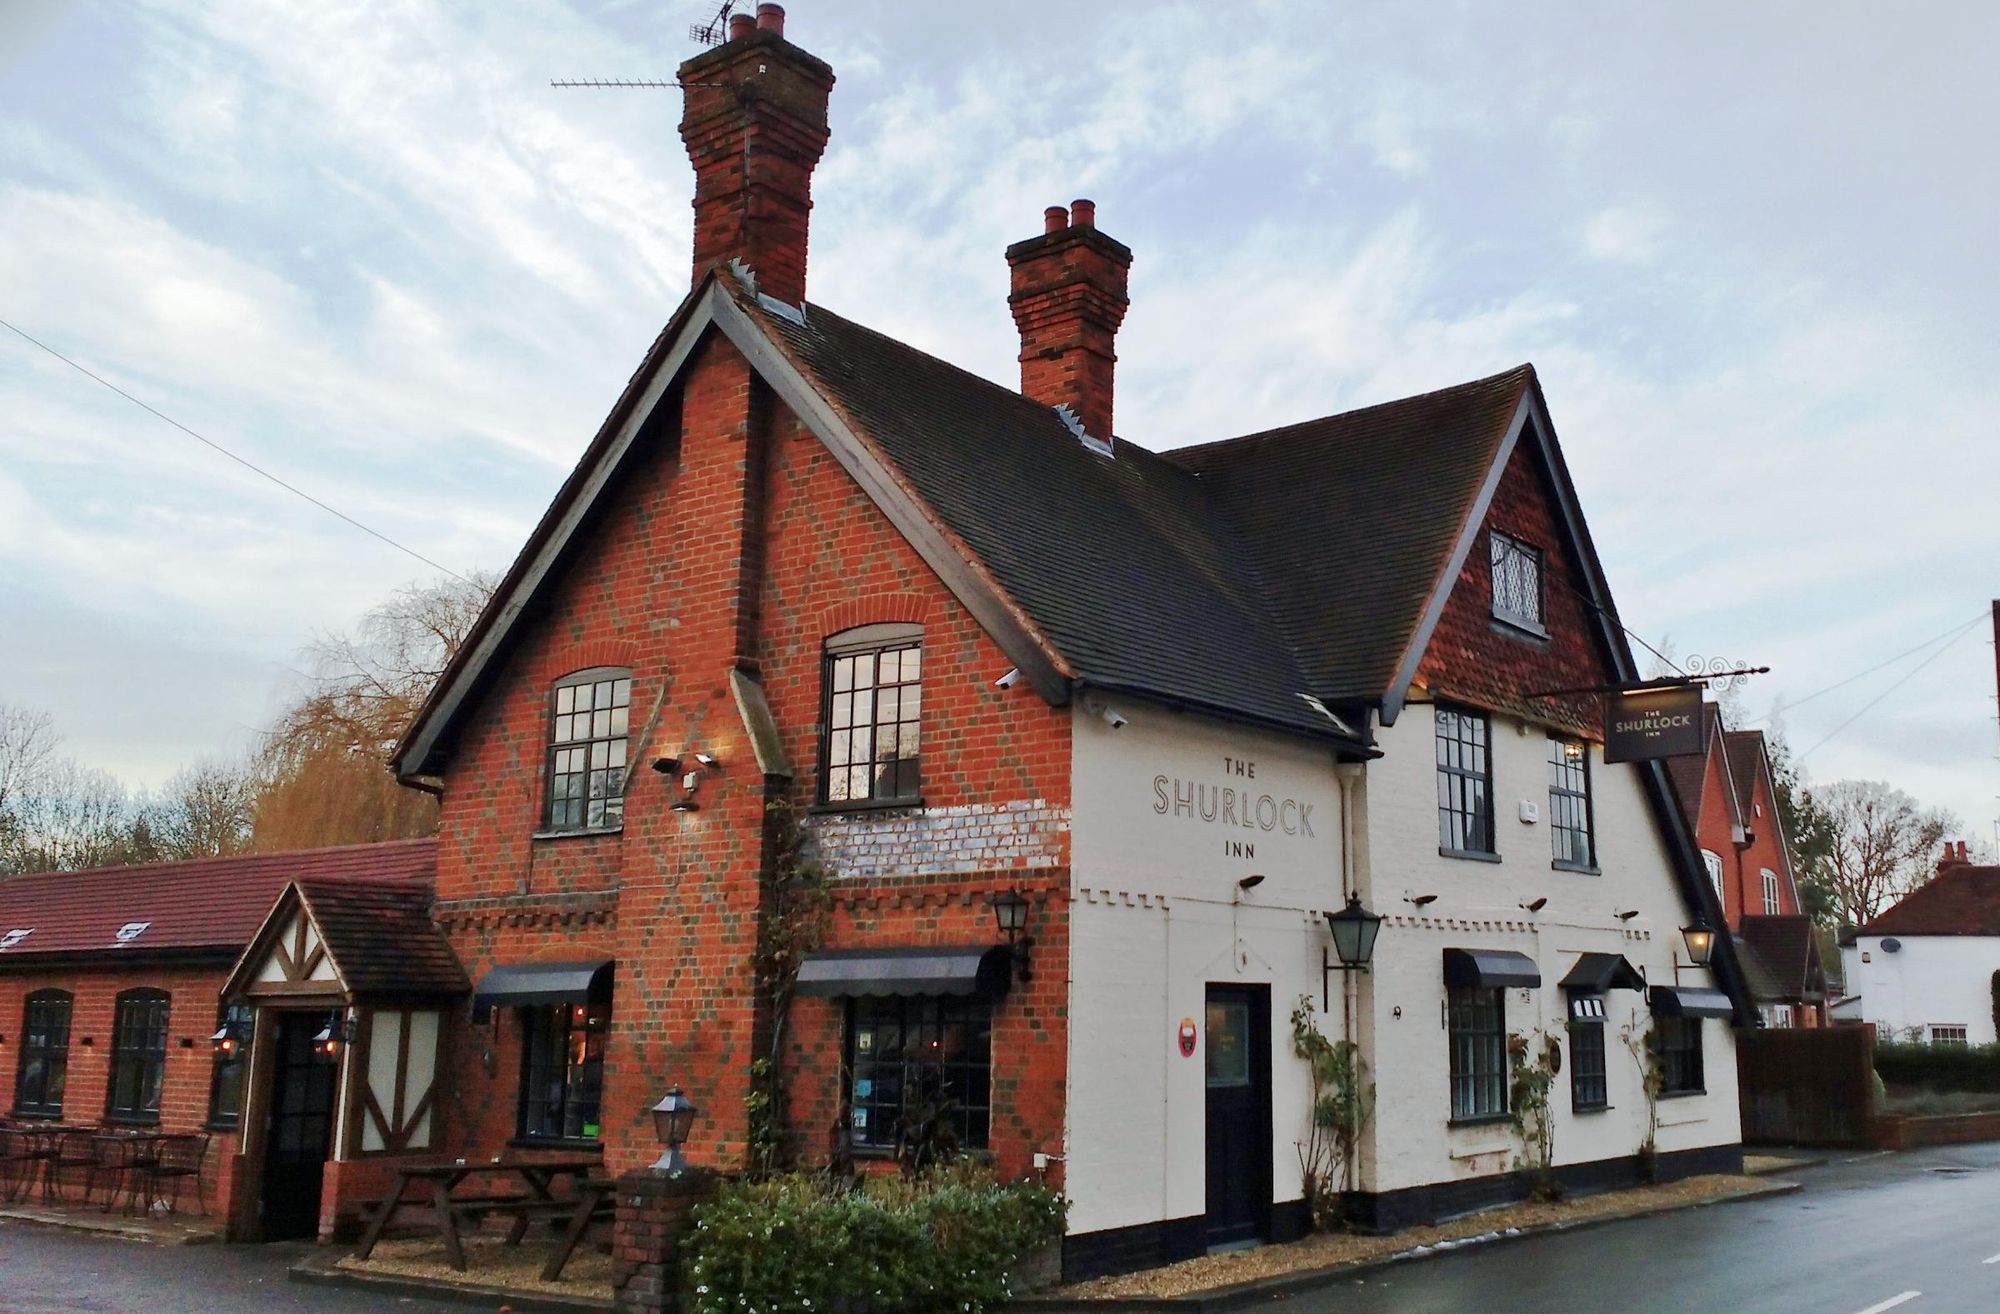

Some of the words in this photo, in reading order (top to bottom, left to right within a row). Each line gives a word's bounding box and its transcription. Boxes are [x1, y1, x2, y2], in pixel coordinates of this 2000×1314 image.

[1616, 715, 1690, 733] SHURLOCK
[1225, 757, 1255, 779] THE
[1153, 774, 1315, 838] SHURLOCK
[1225, 840, 1255, 859] INN
